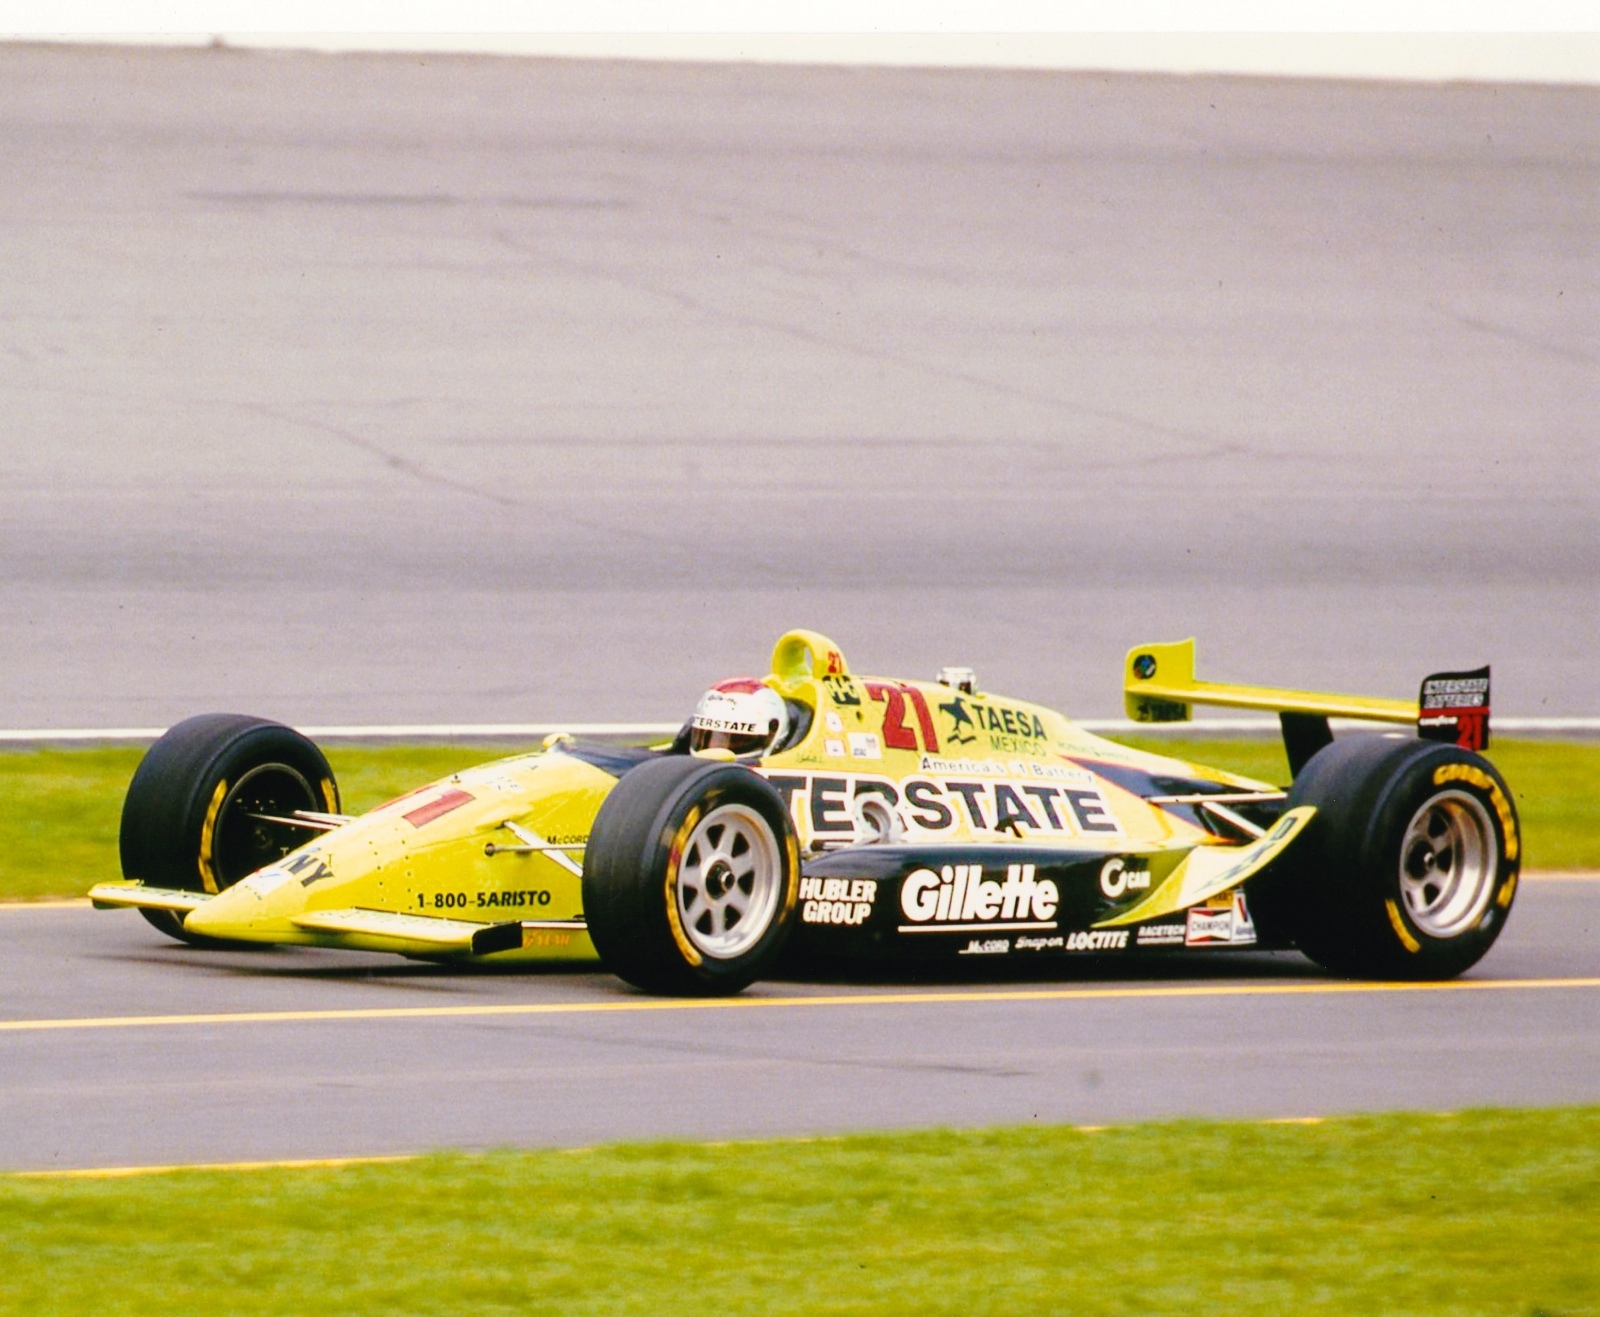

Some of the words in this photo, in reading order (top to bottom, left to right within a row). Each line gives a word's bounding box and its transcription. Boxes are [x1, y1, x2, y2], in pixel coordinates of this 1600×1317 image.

[864, 682, 940, 753] 21
[972, 704, 1047, 741] TAESA
[1456, 713, 1483, 751] 21
[990, 736, 1047, 757] MEXICO
[799, 878, 877, 902] HUBLER
[900, 864, 1059, 922] Gillette
[802, 902, 871, 925] GROUP
[1066, 931, 1130, 951] LOCTITE
